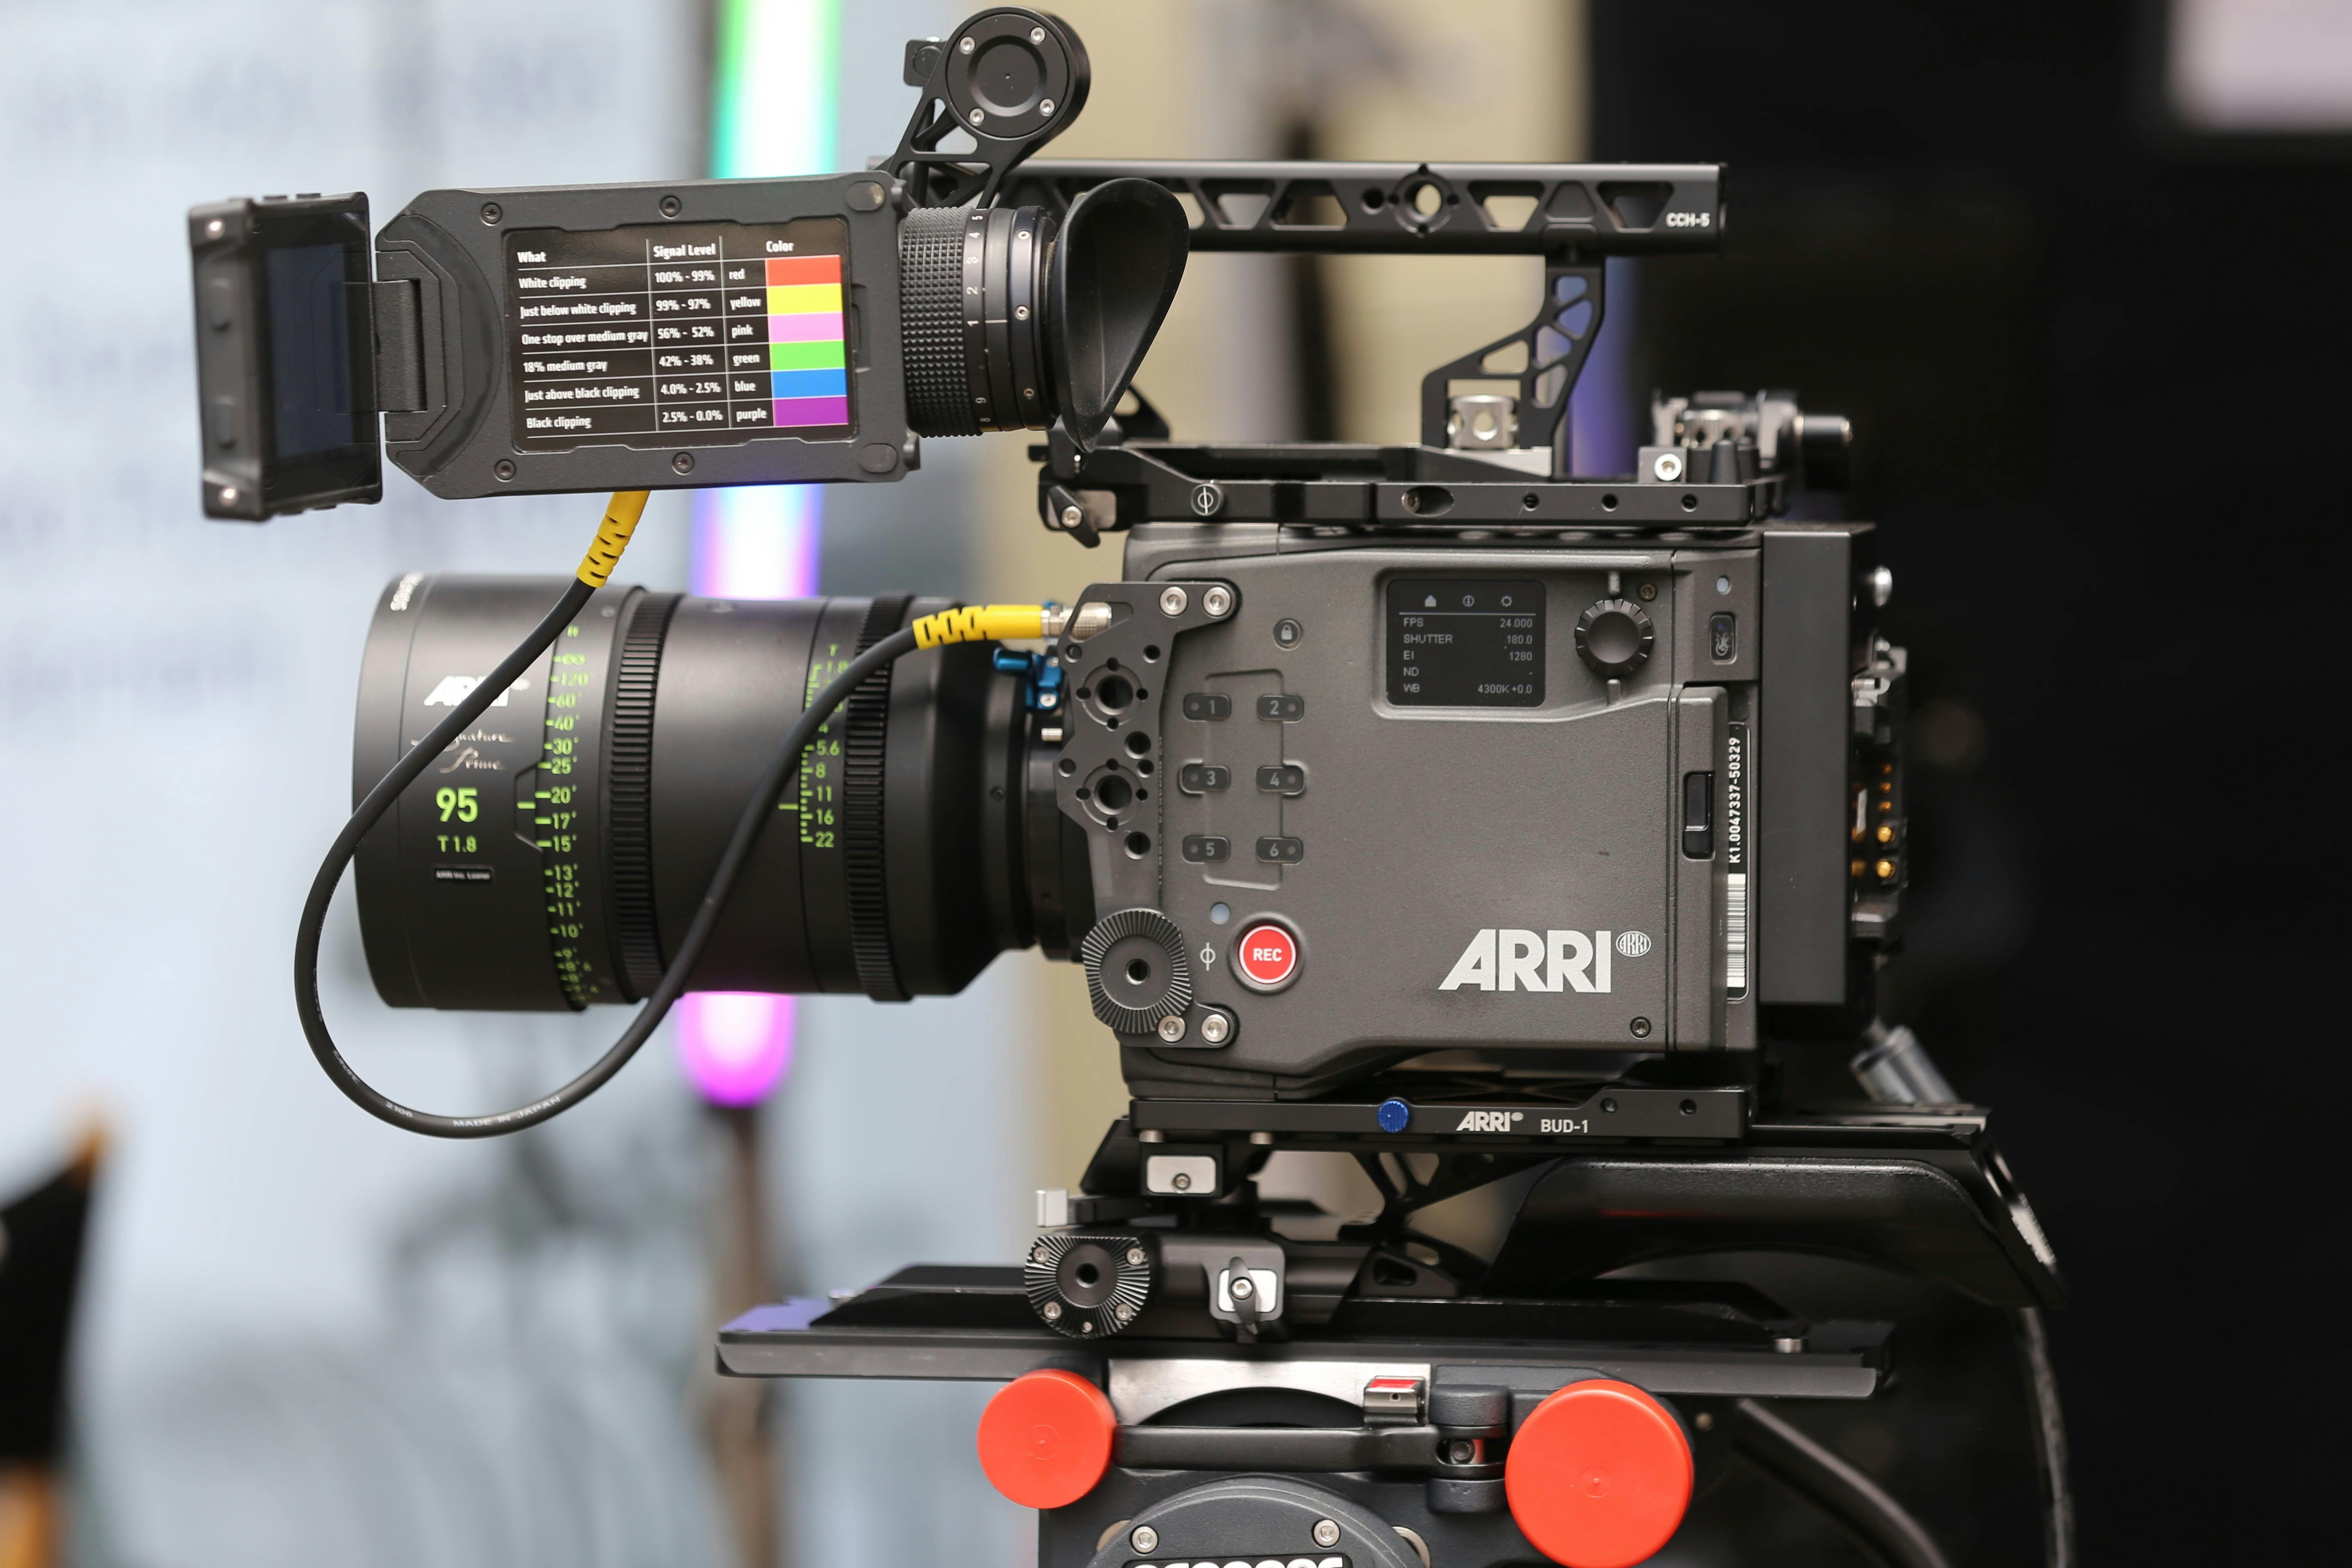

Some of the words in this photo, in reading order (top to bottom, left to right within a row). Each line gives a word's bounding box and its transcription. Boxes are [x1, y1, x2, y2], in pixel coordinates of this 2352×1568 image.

[1666, 212, 1710, 227] CCH-5
[969, 231, 980, 239] 4
[653, 244, 686, 260] Signal
[688, 243, 716, 256] Level
[766, 240, 794, 252] Color
[517, 251, 546, 263] What
[654, 271, 683, 283] 100%
[691, 270, 715, 282] 99%
[729, 268, 745, 280] red
[518, 277, 548, 288] White
[549, 276, 587, 290] clipping
[966, 286, 979, 295] 2
[656, 300, 680, 311] 99%
[687, 298, 711, 310] 97%
[730, 296, 761, 310] yellow
[520, 306, 539, 319] Just
[540, 305, 570, 316] below
[570, 303, 598, 315] white
[599, 302, 637, 316] clipping
[967, 319, 980, 328] 1
[521, 334, 541, 345] One
[542, 334, 564, 346] stop
[565, 334, 586, 343] over
[587, 330, 626, 342] medium
[627, 331, 648, 343] gray
[658, 328, 681, 339] 56%
[692, 326, 714, 338] 52%
[732, 324, 753, 338] pink
[523, 361, 545, 373] 18%
[546, 360, 585, 371] medium
[586, 361, 608, 373] gray
[659, 355, 682, 367] 42%
[690, 354, 714, 366] 38%
[732, 354, 760, 367] green
[660, 383, 687, 395] 4.0%
[695, 382, 721, 393] 2.5%
[734, 380, 756, 392] blue
[525, 390, 544, 403] Just
[545, 389, 574, 400] above
[575, 387, 601, 398] black
[602, 386, 640, 400] clipping
[662, 411, 688, 423] 2.5%
[696, 410, 723, 421] 0.0%
[736, 407, 767, 422] purple
[527, 417, 553, 429] Black
[554, 416, 591, 429] clipping
[1403, 617, 1424, 628] FPS
[1499, 618, 1533, 628] 24.000
[1403, 634, 1453, 644] SHUTTER
[1507, 635, 1533, 645] 180.0
[1403, 650, 1414, 660] EI
[1509, 652, 1533, 661] 1280
[1403, 667, 1419, 677] ND
[423, 675, 510, 707] ARI
[1403, 683, 1420, 693] WB
[1478, 684, 1510, 694] 4300K
[1511, 684, 1533, 694] +0.0
[1209, 699, 1215, 714] 1
[1270, 700, 1279, 715] 2
[816, 739, 841, 756] 5.6
[815, 762, 827, 779] 8
[1207, 771, 1216, 786] 3
[1270, 772, 1280, 787] 4
[817, 785, 833, 802] 11
[1729, 737, 1741, 864] K1.0047337-50329
[435, 786, 479, 823] 95
[816, 808, 835, 825] 16
[437, 835, 450, 853] T
[453, 835, 477, 853] 1.8
[815, 831, 835, 848] 22
[1206, 842, 1215, 856] 5
[1270, 843, 1279, 857] 6
[1253, 948, 1282, 962] REC
[1438, 929, 1612, 993] ARRI
[1618, 932, 1649, 956] ARRI
[452, 1118, 493, 1127] MADE
[497, 1115, 511, 1124] IN
[517, 1095, 561, 1118] JAPAN
[1456, 1111, 1510, 1133] ARRI
[1540, 1118, 1589, 1134] BUD-1
